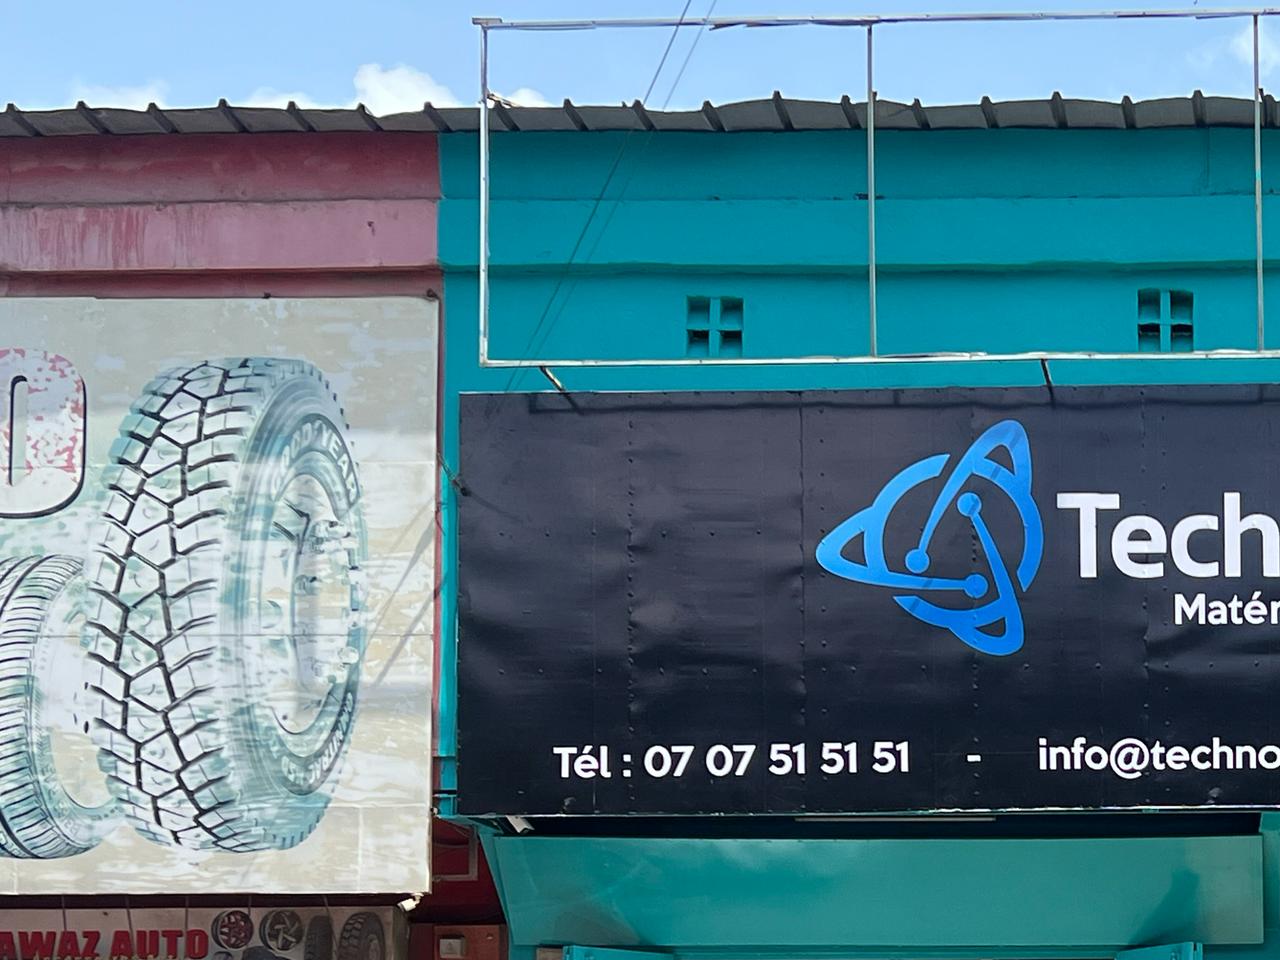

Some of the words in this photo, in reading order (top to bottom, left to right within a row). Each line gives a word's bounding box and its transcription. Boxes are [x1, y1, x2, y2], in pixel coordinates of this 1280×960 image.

[553, 746, 611, 778] Tél
[643, 746, 695, 777] 07
[705, 745, 757, 776] 07
[768, 743, 806, 775] 51
[820, 742, 858, 774] 51
[872, 741, 909, 773] 51
[110, 930, 209, 960] AUTO
